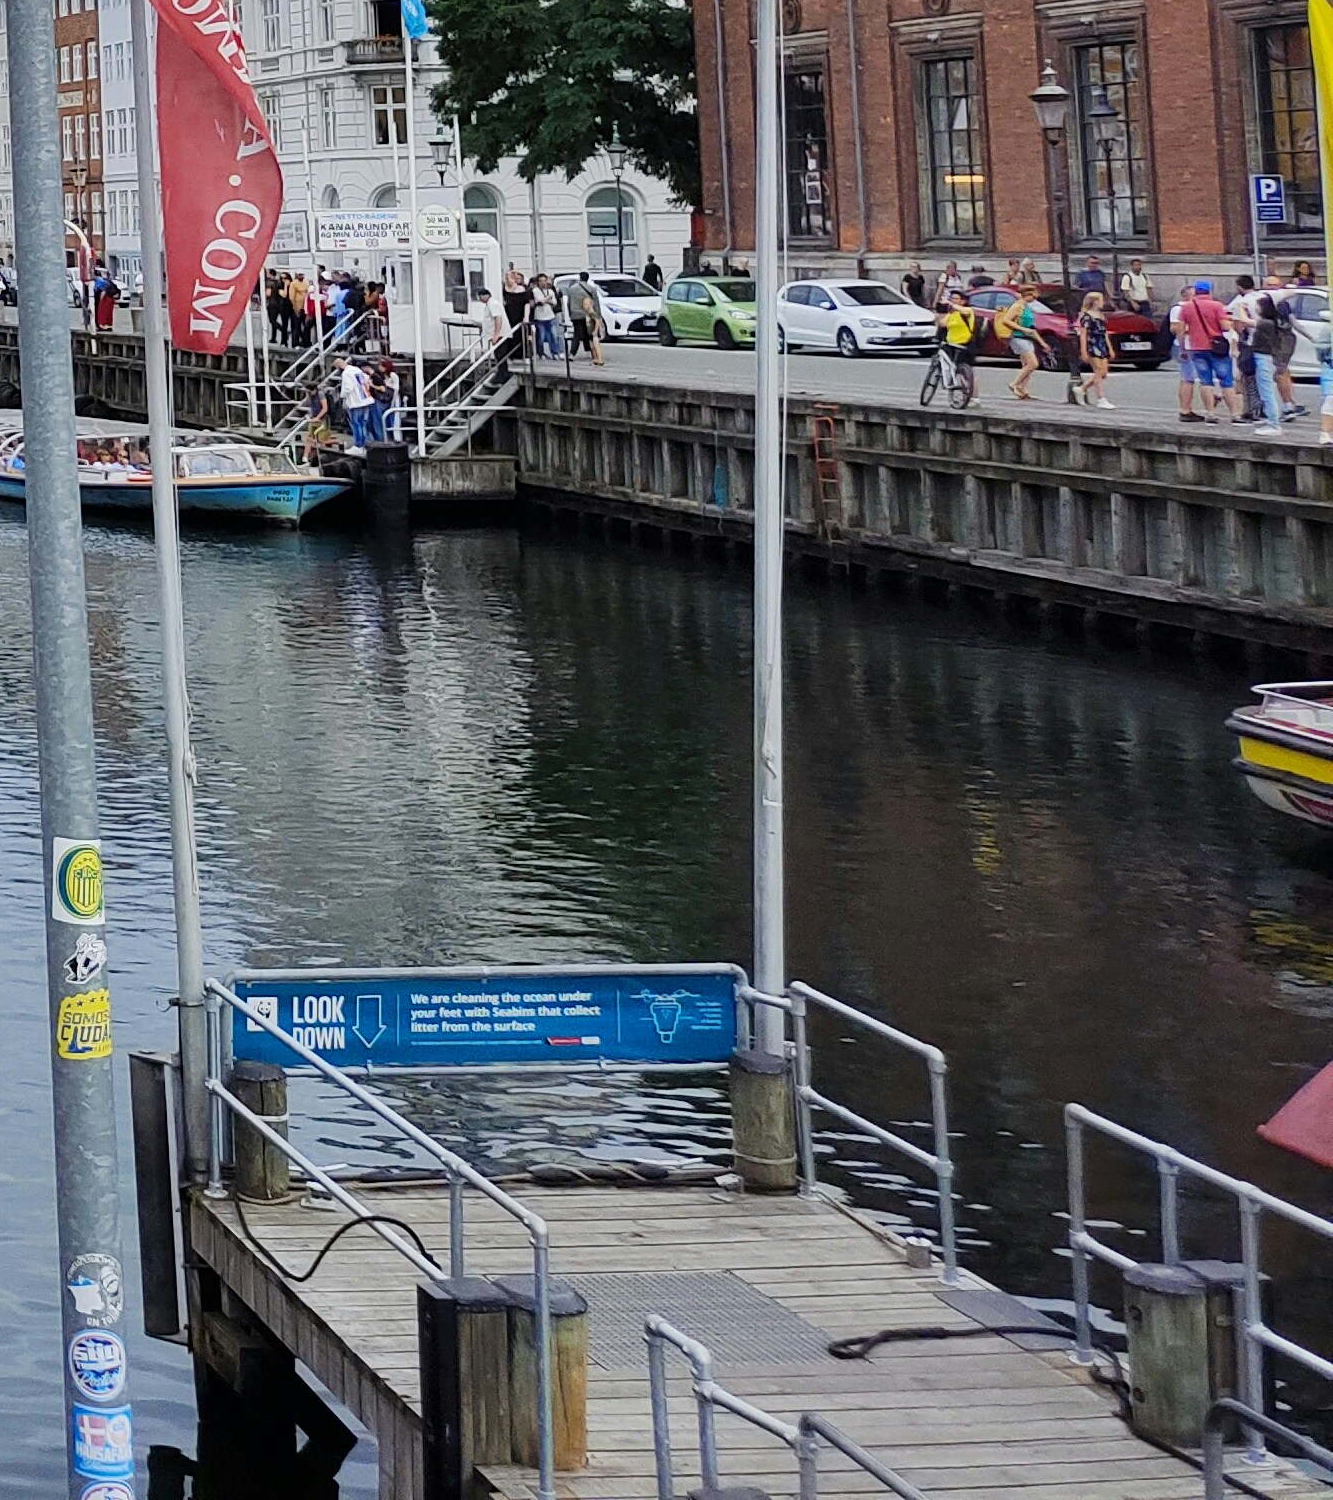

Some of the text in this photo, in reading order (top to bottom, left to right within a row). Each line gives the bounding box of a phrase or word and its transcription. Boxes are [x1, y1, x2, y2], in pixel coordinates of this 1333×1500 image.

[1259, 179, 1276, 201] P
[411, 990, 592, 1005] We are cleaning the ocean under
[292, 995, 346, 1024] LOOK
[411, 1005, 601, 1021] your feet with Seabins that collect
[411, 1020, 536, 1033] litter from the surface
[292, 1026, 346, 1050] DOWN
